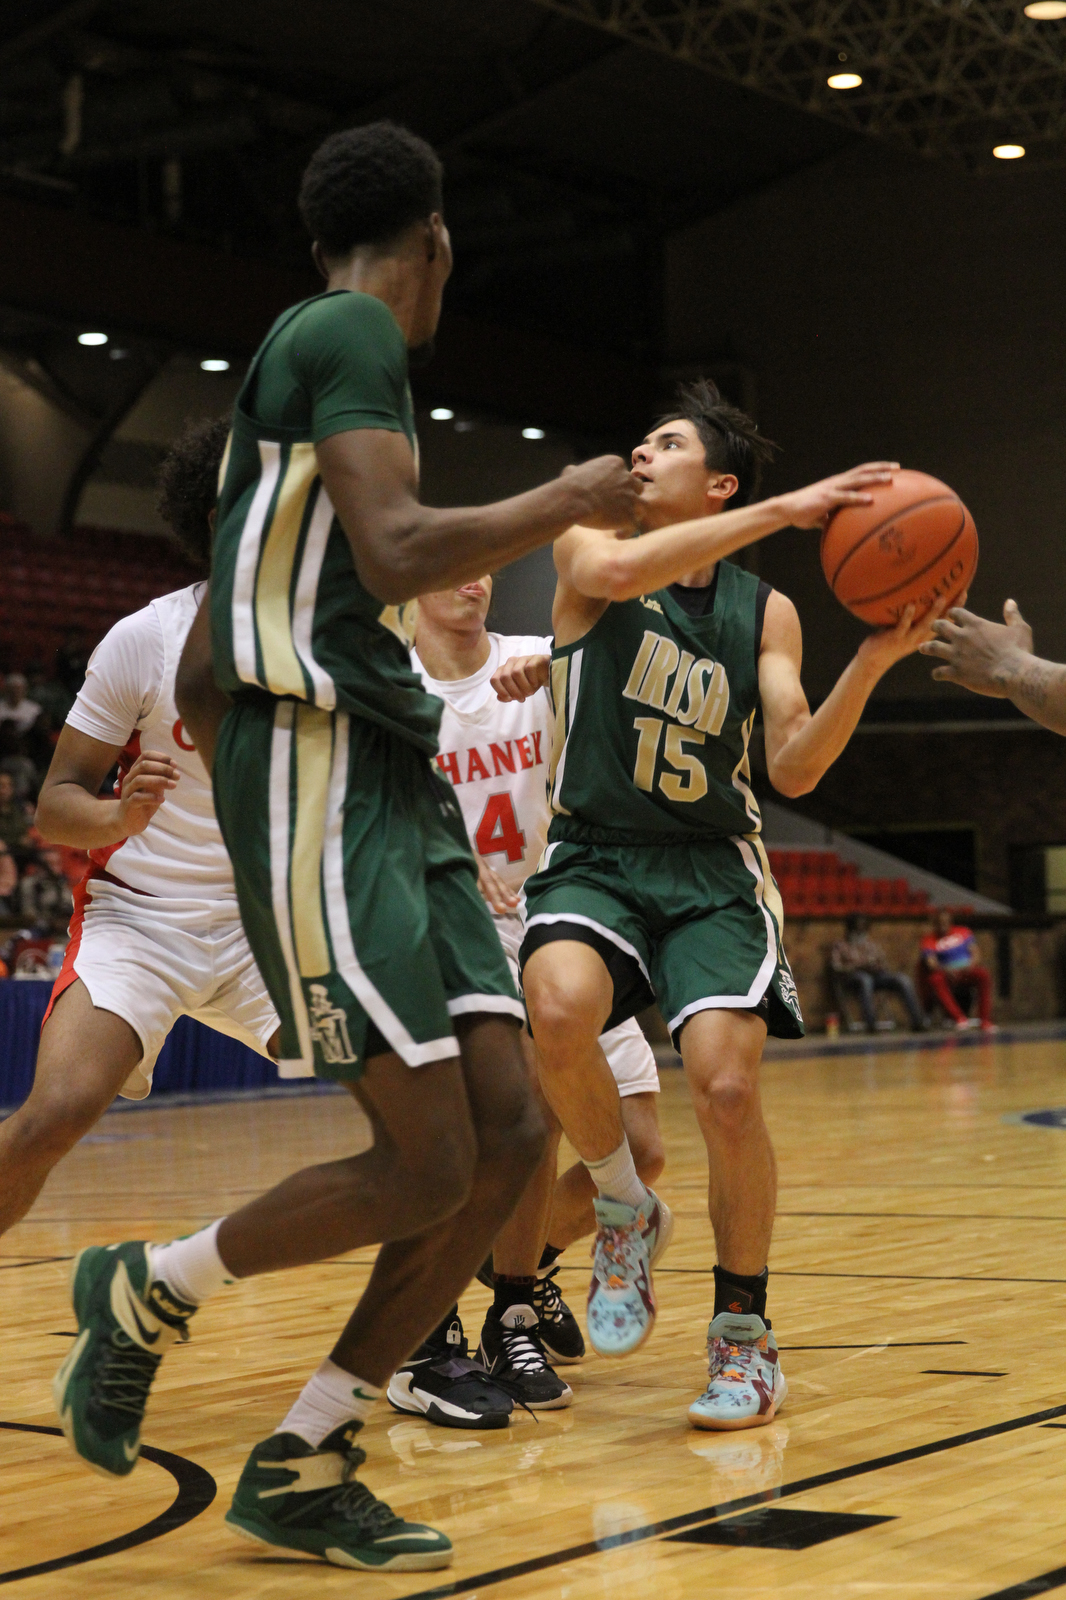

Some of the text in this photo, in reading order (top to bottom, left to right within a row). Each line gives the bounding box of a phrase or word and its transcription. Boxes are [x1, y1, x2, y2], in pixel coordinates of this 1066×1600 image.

[622, 629, 730, 737] IRISH
[633, 716, 708, 803] 15
[473, 790, 528, 865] 4
